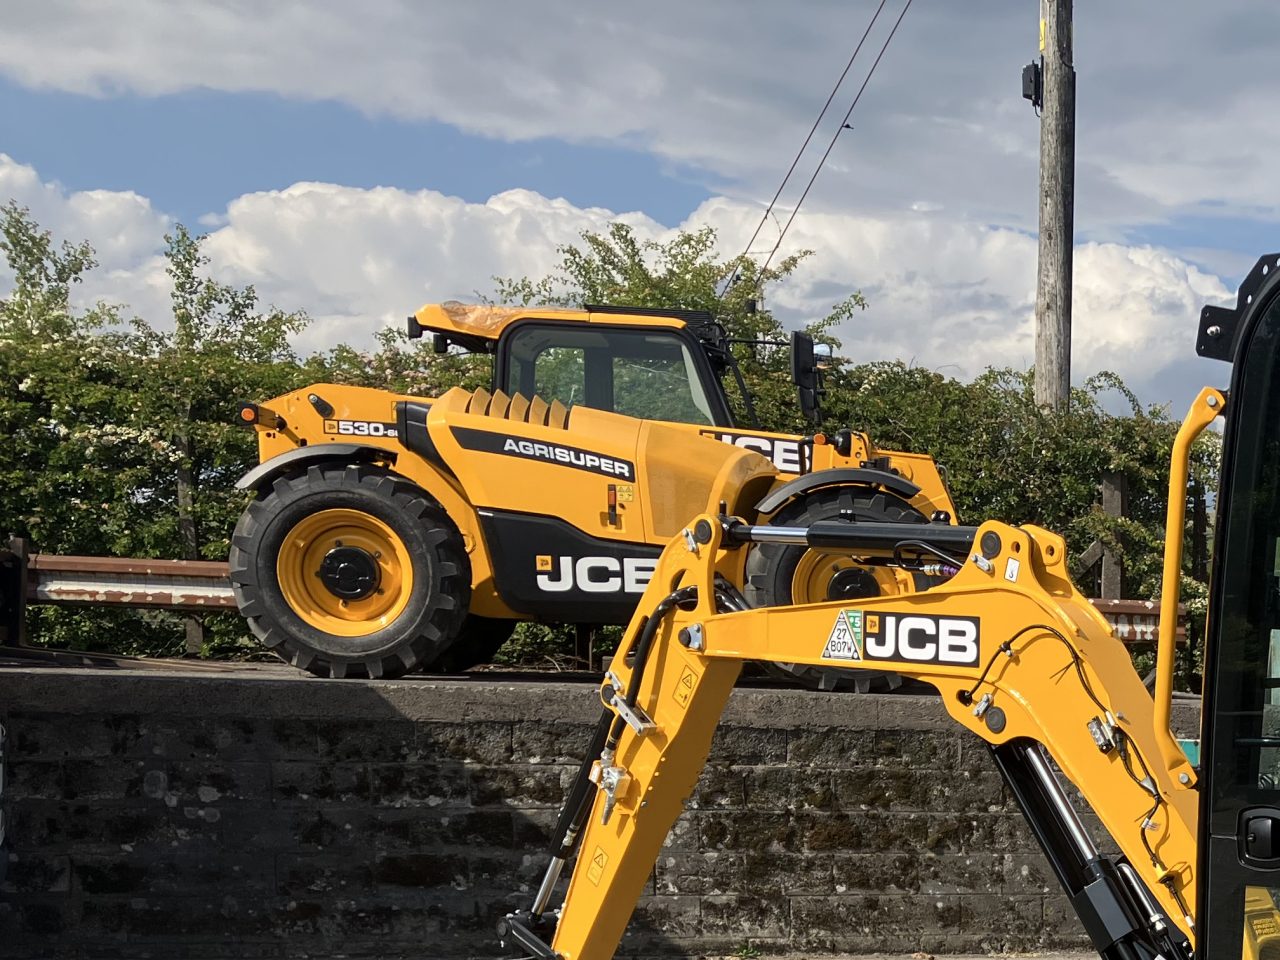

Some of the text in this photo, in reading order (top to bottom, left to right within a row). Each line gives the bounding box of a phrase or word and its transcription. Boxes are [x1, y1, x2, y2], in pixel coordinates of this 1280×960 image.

[503, 438, 630, 477] AGRISUPER
[836, 628, 847, 640] 27
[865, 615, 978, 663] JCB
